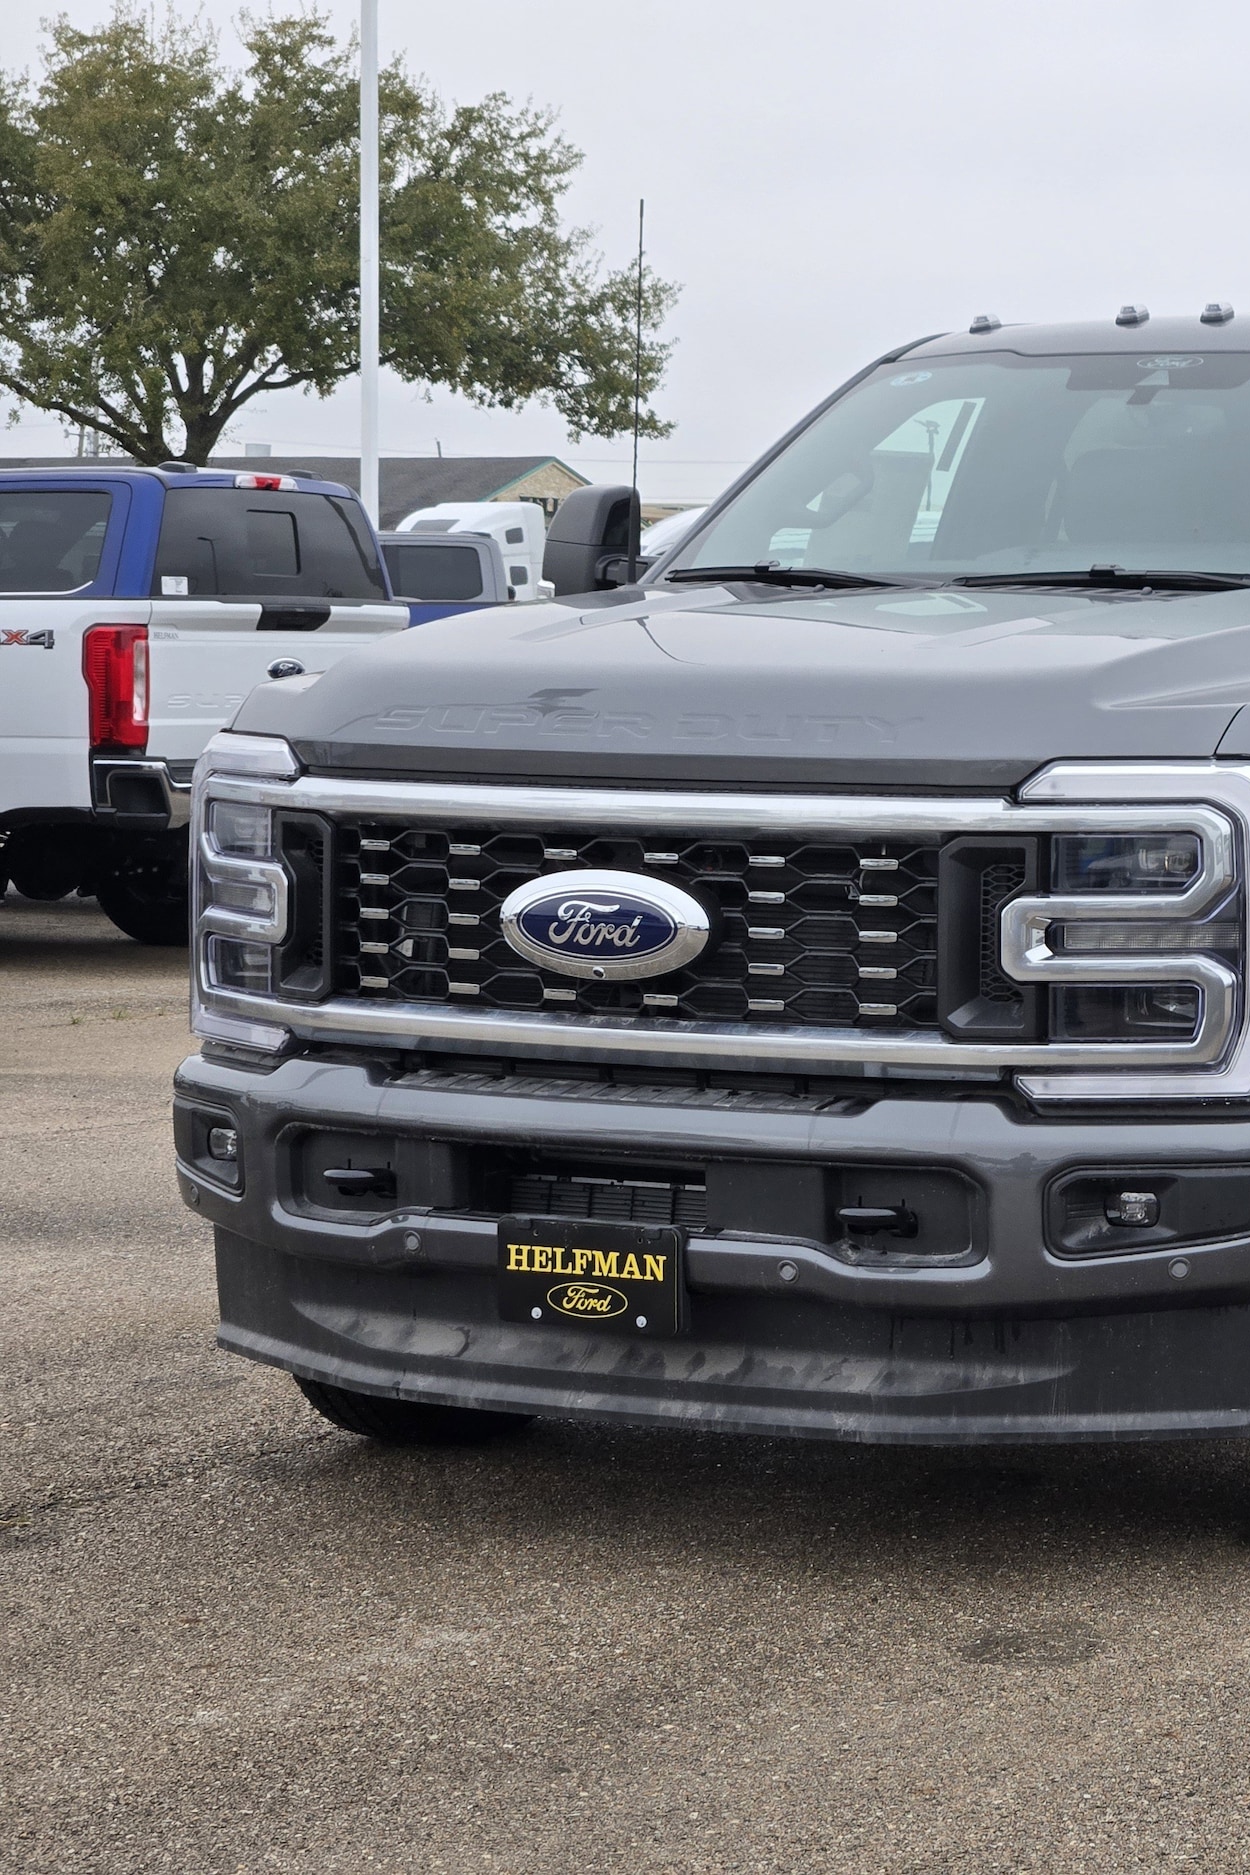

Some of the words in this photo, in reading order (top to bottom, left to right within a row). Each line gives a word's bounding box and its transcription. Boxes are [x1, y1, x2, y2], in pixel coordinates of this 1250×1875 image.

[0, 629, 55, 650] X4
[374, 704, 655, 739] SUPER
[671, 712, 926, 744] DUTY
[548, 899, 643, 948] Ford
[506, 1243, 667, 1282] HELFMAN
[562, 1285, 613, 1312] Ford
